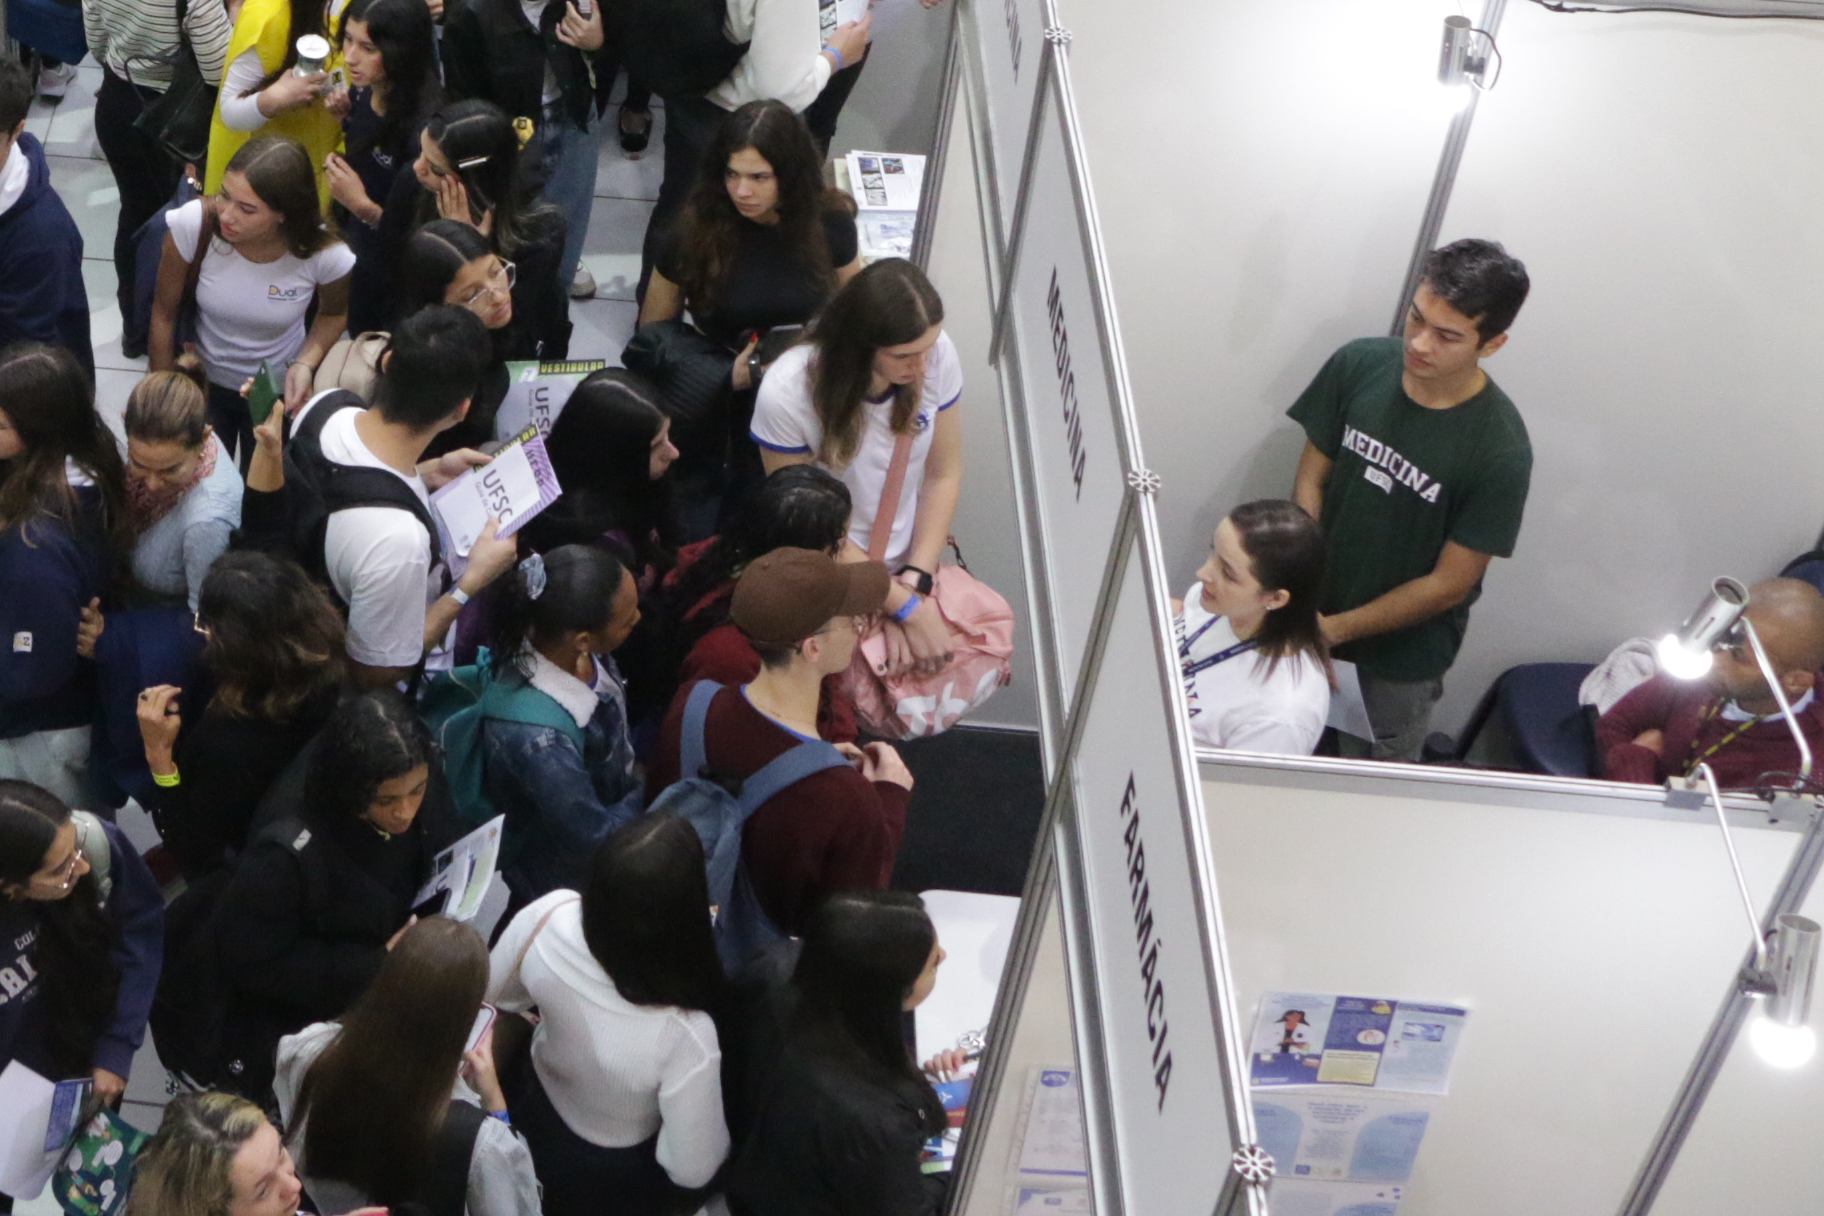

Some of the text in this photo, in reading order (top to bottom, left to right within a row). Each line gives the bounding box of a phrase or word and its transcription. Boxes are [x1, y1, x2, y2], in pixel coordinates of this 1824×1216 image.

[268, 284, 298, 297] Dual
[541, 361, 605, 374] VESTIBULAR
[1047, 263, 1087, 506] MEDICINA
[534, 386, 551, 437] UFS
[1341, 424, 1443, 504] MEDICINA
[482, 468, 514, 525] UFSC
[1120, 769, 1173, 1117] FARMÁCIA
